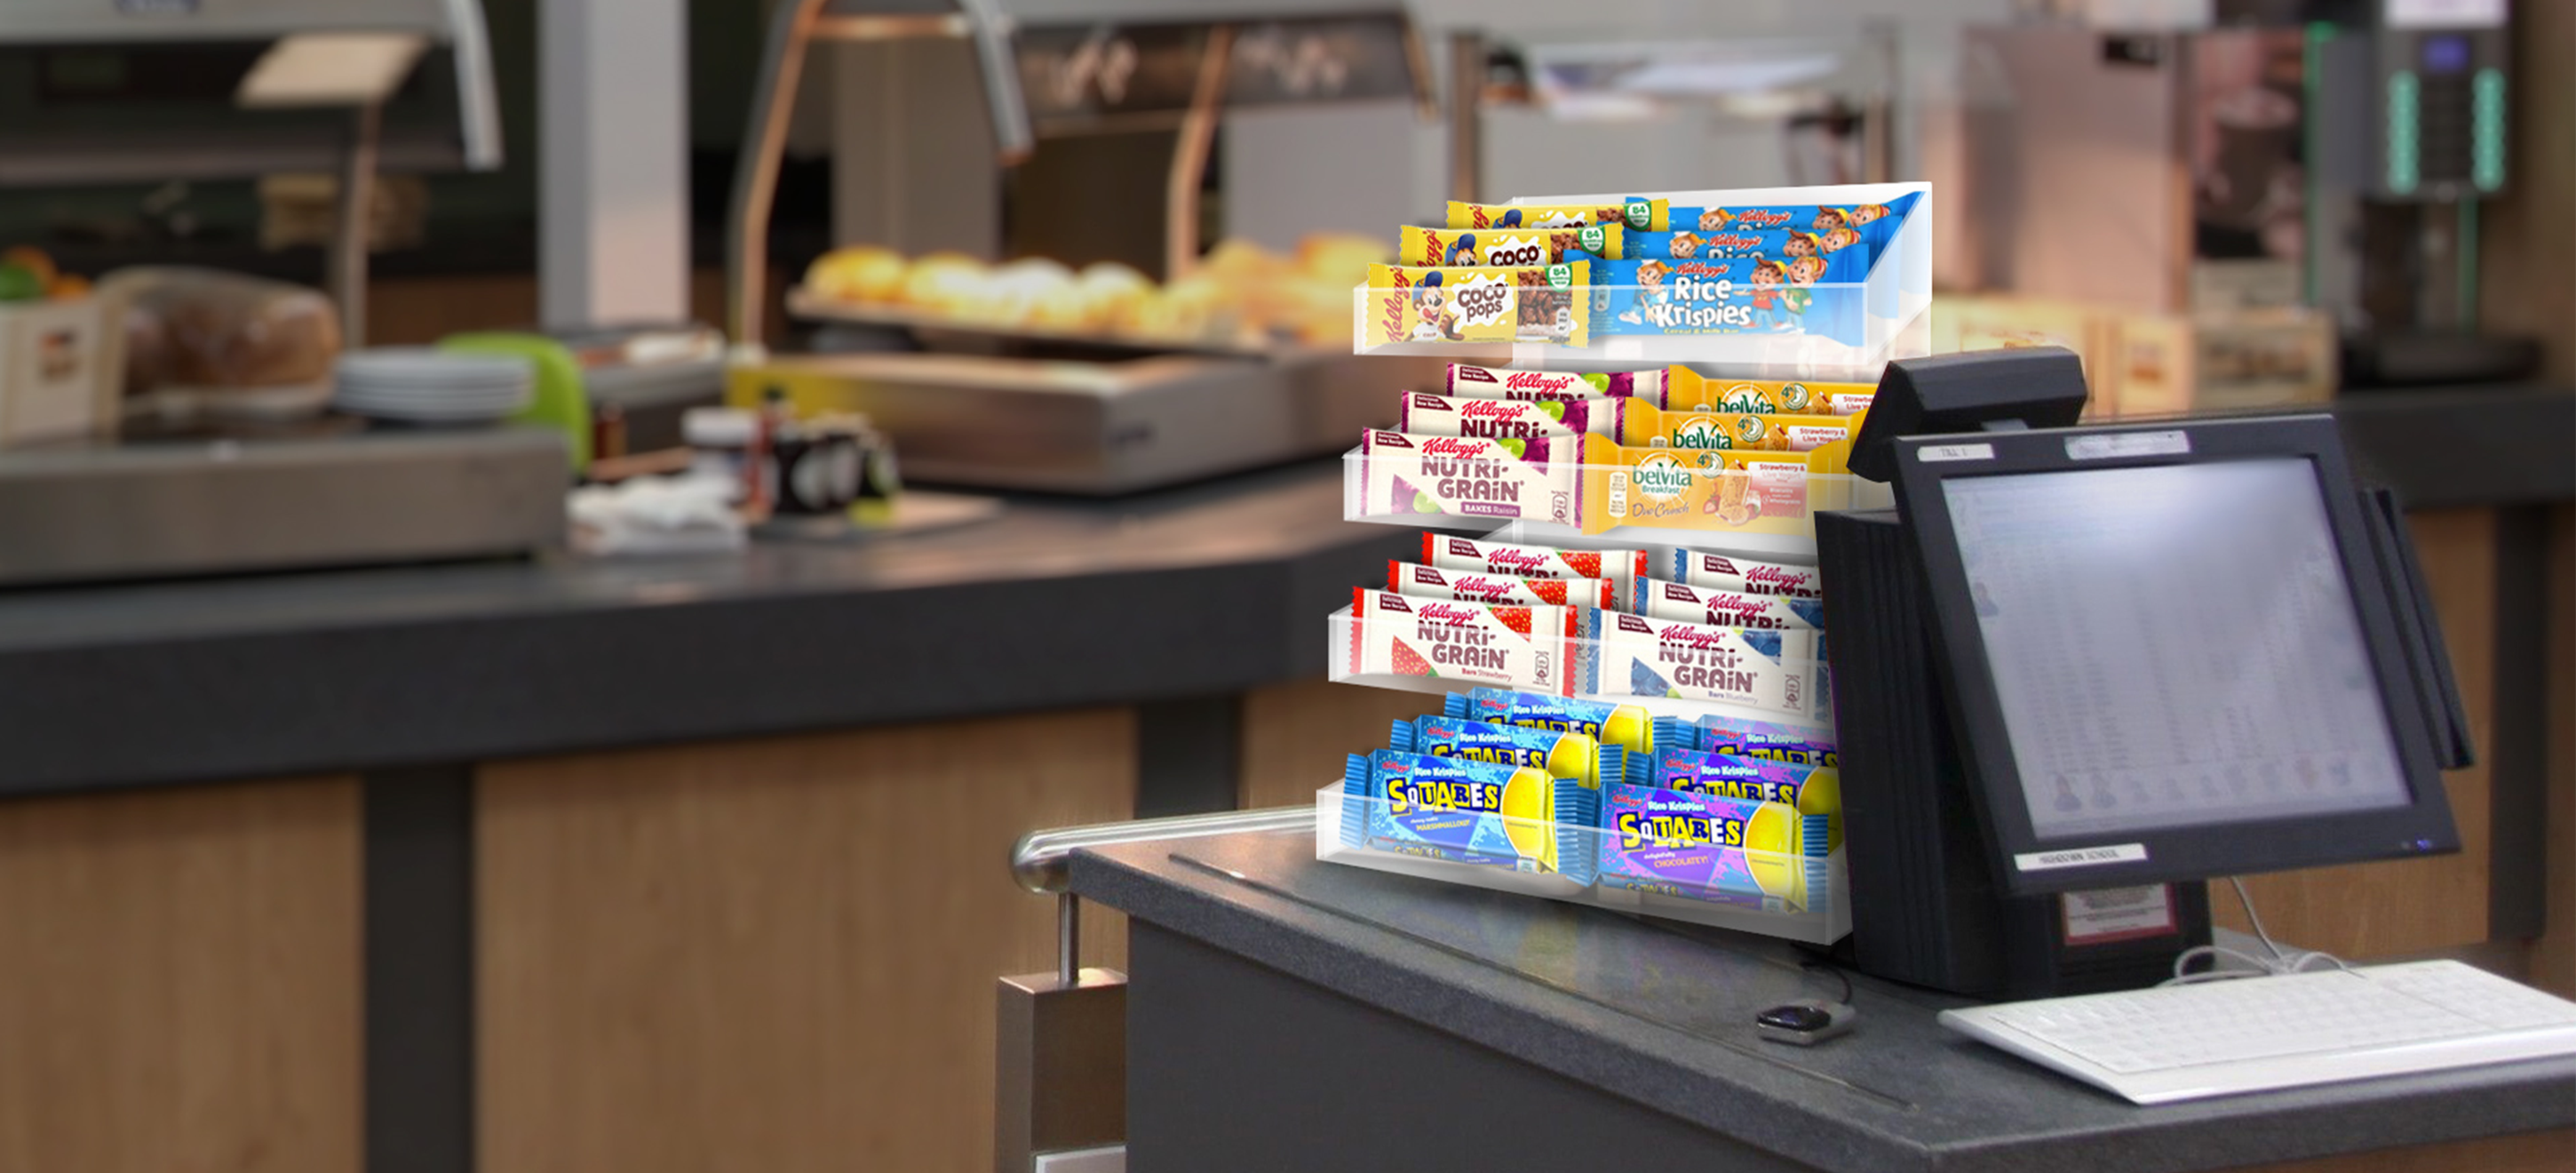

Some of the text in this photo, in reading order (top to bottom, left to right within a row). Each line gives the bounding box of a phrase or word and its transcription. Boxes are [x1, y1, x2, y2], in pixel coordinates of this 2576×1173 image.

[1632, 205, 1646, 214] 84
[1737, 209, 1792, 225] Kellogg's
[1586, 230, 1600, 239] 84
[1709, 234, 1763, 250] Kellogg's
[1490, 245, 1539, 267] COCO
[1553, 267, 1567, 276] 84
[1676, 262, 1729, 277] Kellogg's
[1458, 283, 1507, 307] COCO
[1674, 275, 1732, 301] Rice
[1382, 266, 1411, 342] Kellogg's
[1467, 299, 1503, 322] pops
[1655, 301, 1752, 328] Krispies
[1507, 371, 1569, 395] Kellogg's
[1461, 400, 1523, 422] Kellogg's
[1673, 423, 1732, 449] belVita
[1422, 437, 1484, 459] Kellogg's
[1633, 459, 1692, 486] belVita
[1642, 485, 1681, 495] Breakfast
[1465, 504, 1518, 515] BAKES Raisin
[1633, 501, 1690, 518] Duo Crunch
[1488, 547, 1544, 571] Kellogg's
[1745, 565, 1806, 590] Kellogg's
[1454, 575, 1509, 600] Kellogg's
[1419, 602, 1475, 626] Kellogg's
[1707, 594, 1766, 618] Kellogg's
[1660, 625, 1721, 650] Kellogg's
[1477, 669, 1513, 682] Strawberry
[1708, 690, 1759, 706] Bars Blueberry
[1513, 705, 1566, 715] Rice Krispies
[1459, 733, 1511, 744] Rice Krispies
[1746, 733, 1804, 745] Rice Krispies
[1414, 767, 1467, 778] Rice Krispies
[1700, 765, 1759, 777] Rice Krispies
[1648, 801, 1705, 812] Rice Krispies
